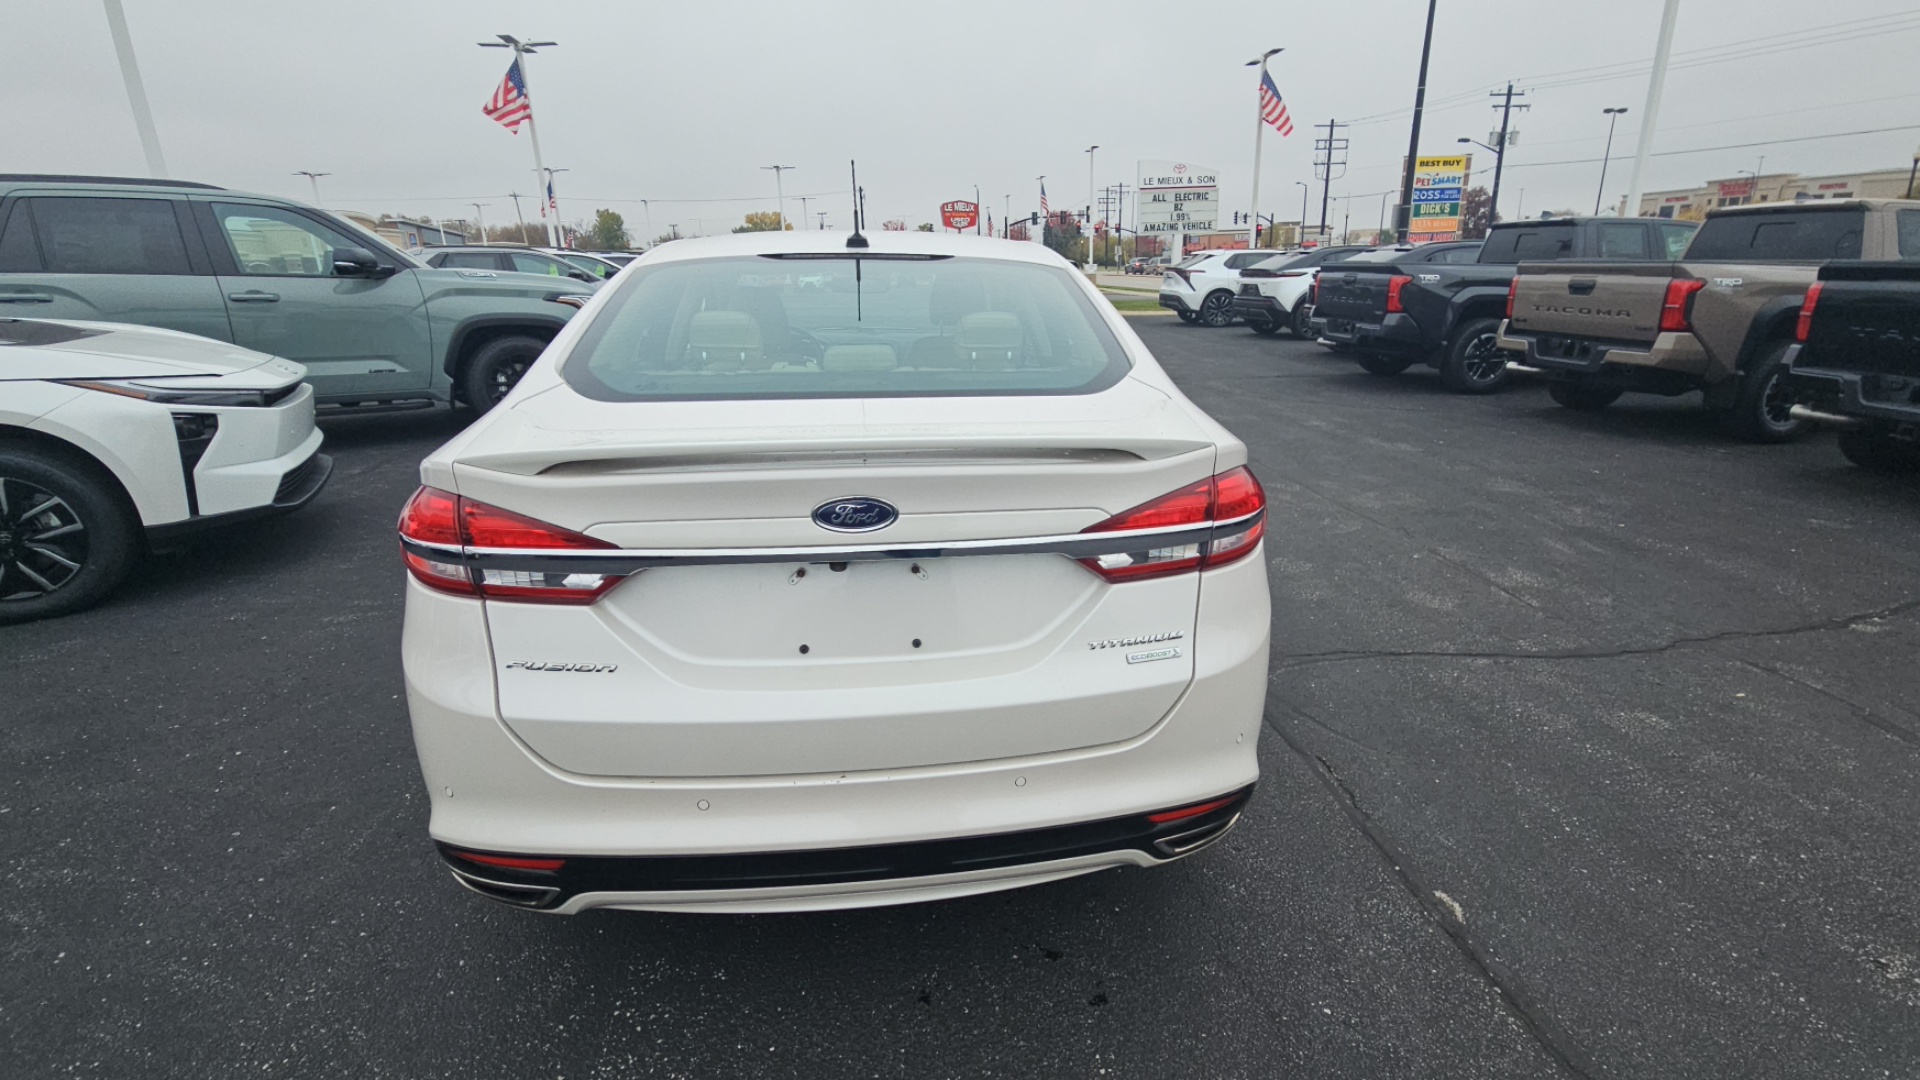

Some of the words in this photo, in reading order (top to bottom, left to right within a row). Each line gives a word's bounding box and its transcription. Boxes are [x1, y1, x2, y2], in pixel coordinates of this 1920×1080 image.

[1442, 159, 1462, 167] BUY
[1143, 178, 1154, 186] LE
[1158, 176, 1184, 185] MIEUX
[1187, 176, 1193, 184] &
[1197, 175, 1216, 184] SON
[1151, 193, 1167, 202] ALL
[1174, 191, 1210, 201] ELECTRIC
[1413, 190, 1441, 200] ROSS
[944, 203, 953, 212] LE
[954, 202, 975, 212] MIEUX
[1173, 203, 1184, 212] BZ
[1420, 203, 1450, 214] DICK'S
[1170, 212, 1191, 221] 1.99%
[1144, 223, 1179, 232] AMAZING
[1182, 221, 1213, 231] VEHICLE
[1412, 220, 1432, 228] ULTA
[1714, 277, 1743, 287] TRD
[1532, 303, 1632, 318] TACOMA
[831, 504, 879, 525] Ford
[1087, 630, 1185, 651] TITANIUM
[505, 660, 619, 673] FUSION
